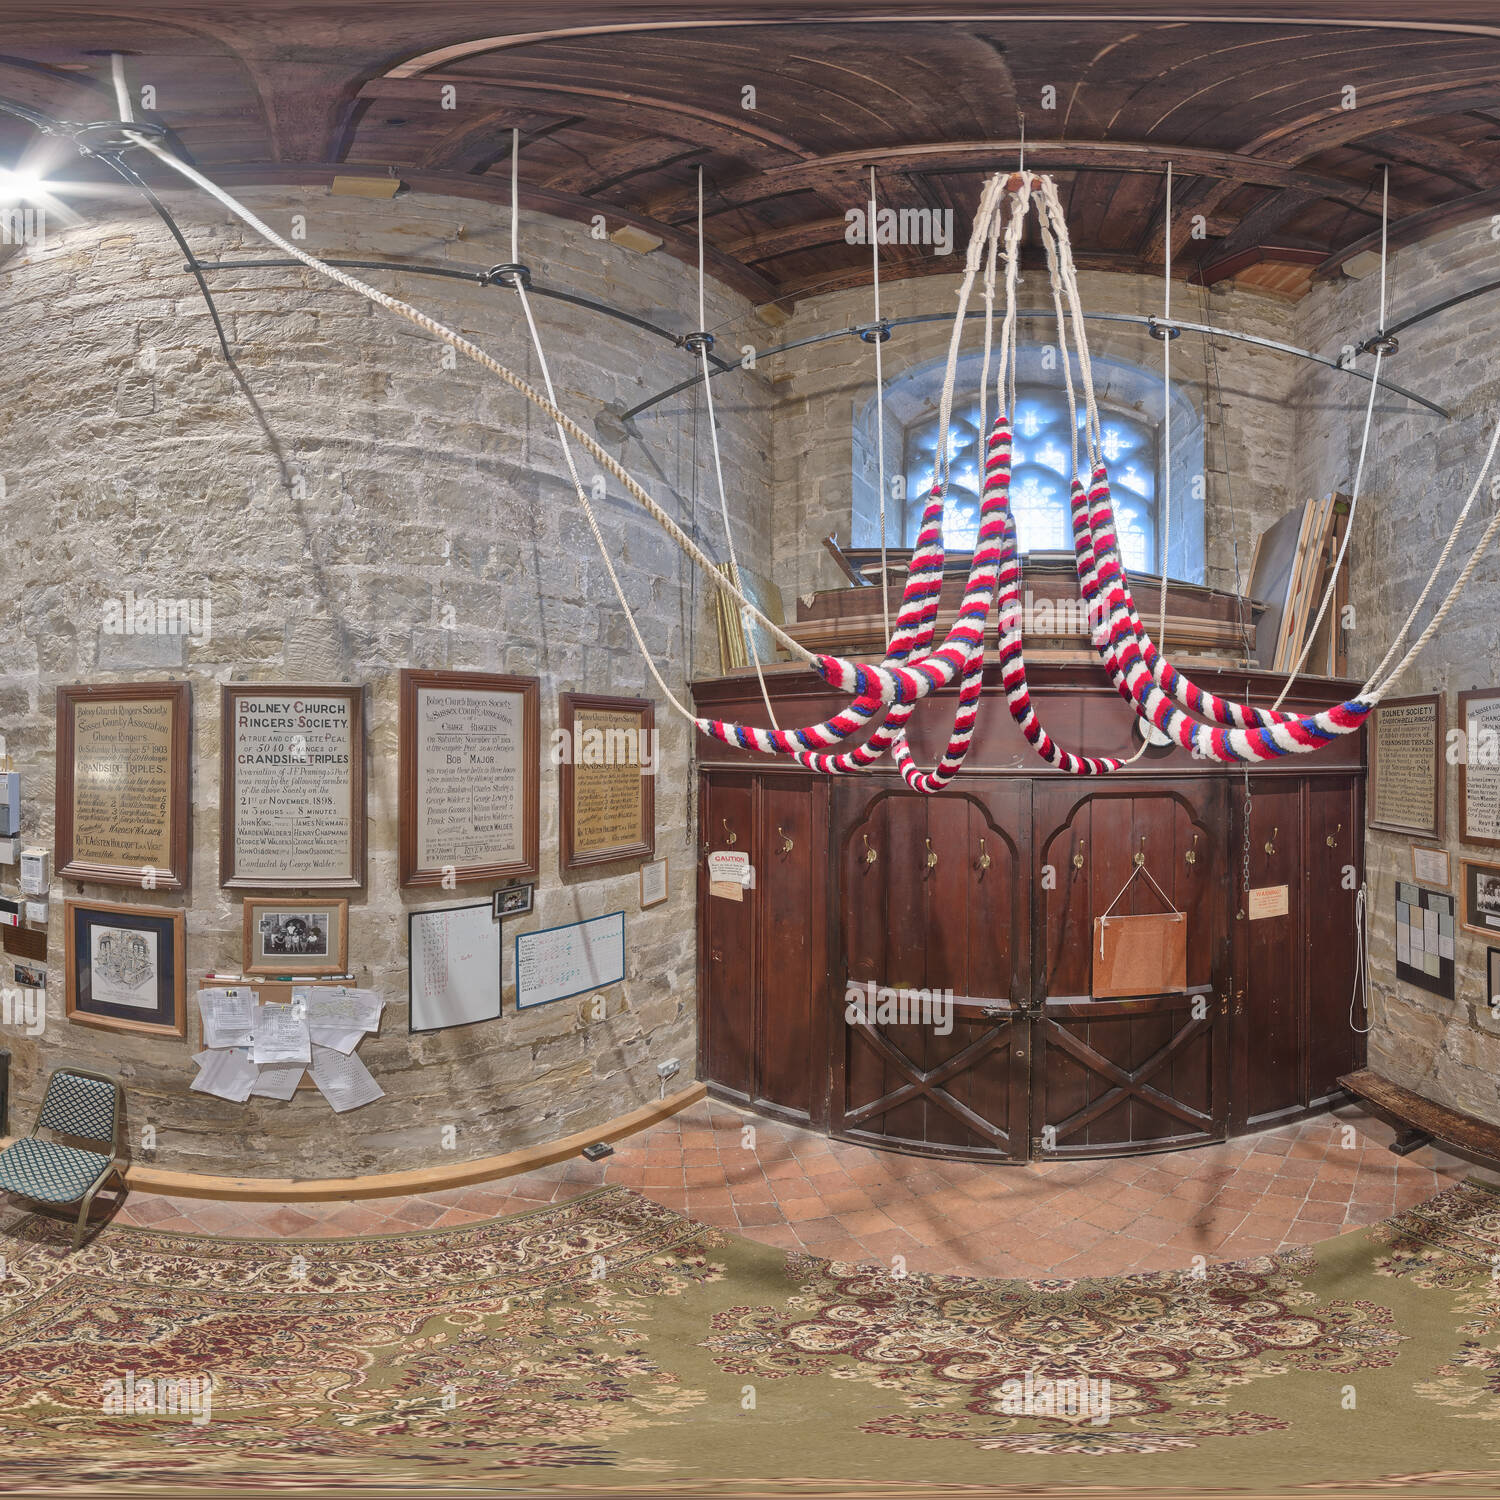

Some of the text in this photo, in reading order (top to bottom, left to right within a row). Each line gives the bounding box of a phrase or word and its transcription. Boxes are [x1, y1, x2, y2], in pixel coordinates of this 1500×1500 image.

[240, 701, 345, 713] BOLNEY CHURCH
[1406, 707, 1433, 715] SOCIETY
[325, 733, 347, 742] PEAL
[238, 755, 348, 764] GRANDSIRE TRIPLES
[470, 755, 494, 764] MAJOR
